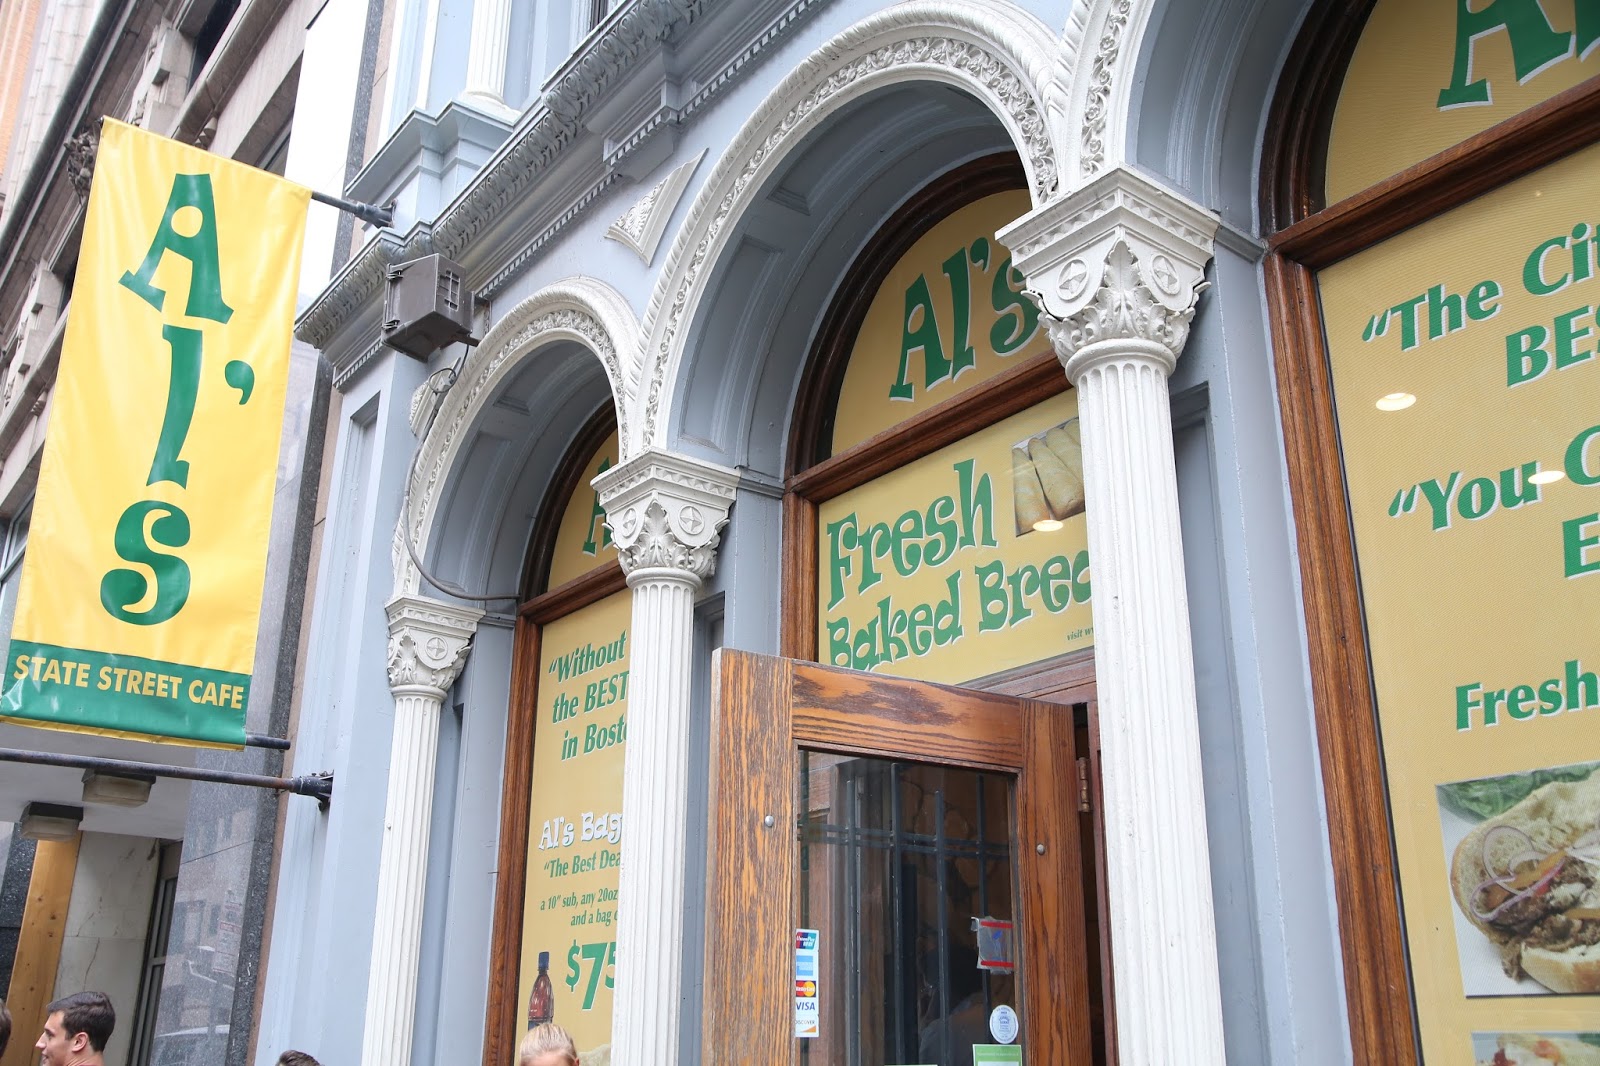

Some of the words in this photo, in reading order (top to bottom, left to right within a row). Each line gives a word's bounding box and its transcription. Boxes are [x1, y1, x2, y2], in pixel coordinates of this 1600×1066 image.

[888, 237, 1041, 402] Al's
[1505, 304, 1600, 388] BE
[827, 459, 998, 612] Fresh
[827, 569, 964, 672] Baked
[13, 655, 91, 687] STATE
[97, 666, 182, 699] STREET
[188, 680, 244, 709] CAFE
[552, 692, 579, 724] the
[584, 670, 630, 713] BEST
[1456, 659, 1600, 732] Fresh
[561, 730, 578, 761] in
[538, 816, 575, 850] Al's
[581, 811, 622, 844] Bag
[572, 851, 597, 874] Best
[540, 900, 546, 911] a
[581, 892, 595, 908] any
[571, 910, 587, 926] and
[588, 914, 594, 925] a
[596, 908, 612, 927] bag
[796, 1002, 815, 1011] VISA
